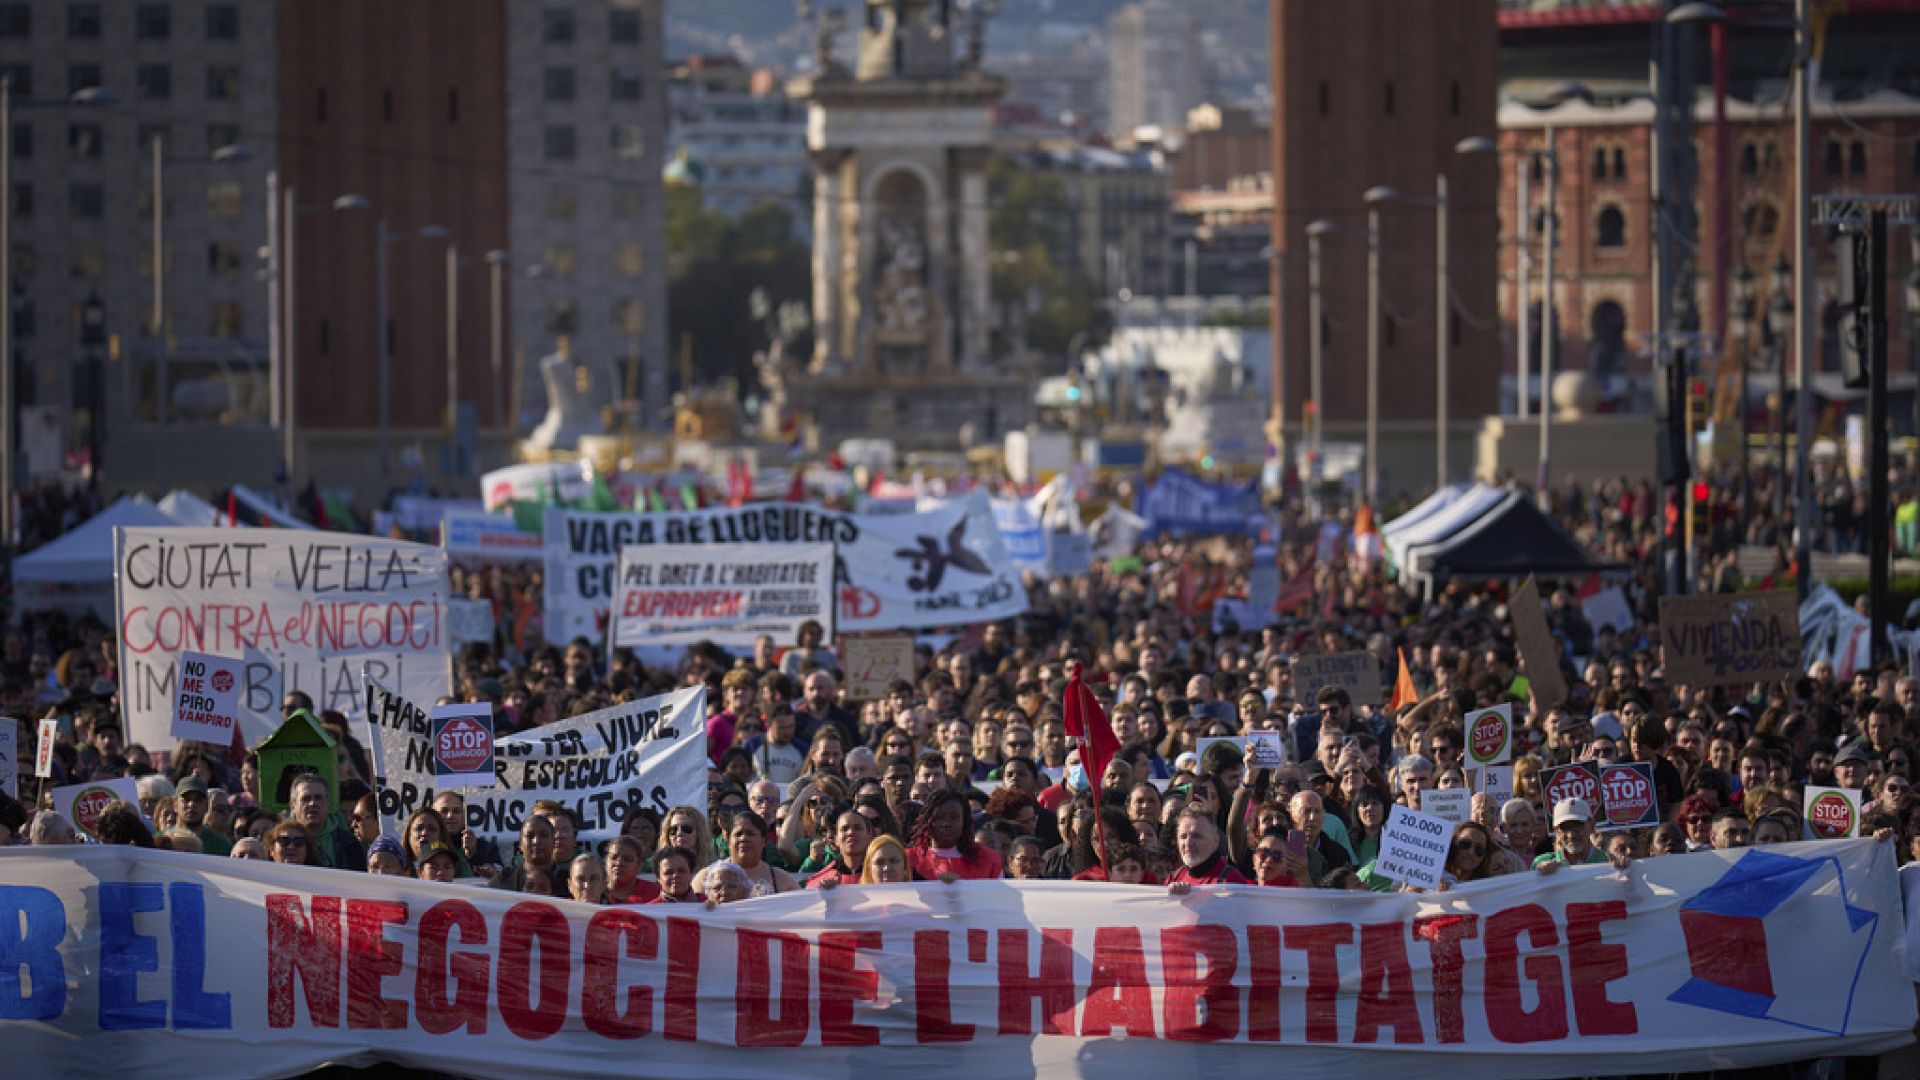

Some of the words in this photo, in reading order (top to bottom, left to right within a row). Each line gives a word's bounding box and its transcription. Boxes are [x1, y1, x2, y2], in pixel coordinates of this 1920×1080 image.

[624, 588, 744, 618] EXPROPIEM
[123, 601, 281, 653] CONTRA
[185, 660, 206, 676] NO
[182, 677, 205, 693] ME
[180, 694, 215, 712] PIRO
[178, 709, 232, 728] VAMPIRO
[441, 731, 487, 750] STOP
[1475, 722, 1503, 740] STOP
[522, 749, 640, 791] ESPECULAR
[1550, 778, 1595, 804] STOP
[1602, 780, 1646, 801] STOP
[1816, 804, 1848, 819] STOP
[1400, 813, 1443, 836] 20.000
[1387, 829, 1445, 854] ALQUILERES
[1391, 846, 1435, 867] SOCIALES
[1383, 861, 1398, 872] EN
[1406, 868, 1433, 883] AÑOS
[98, 882, 232, 1031] EL
[265, 895, 701, 1041] NEGOCI
[735, 926, 883, 1047] DE
[914, 900, 1638, 1045] L'HABITATGE
